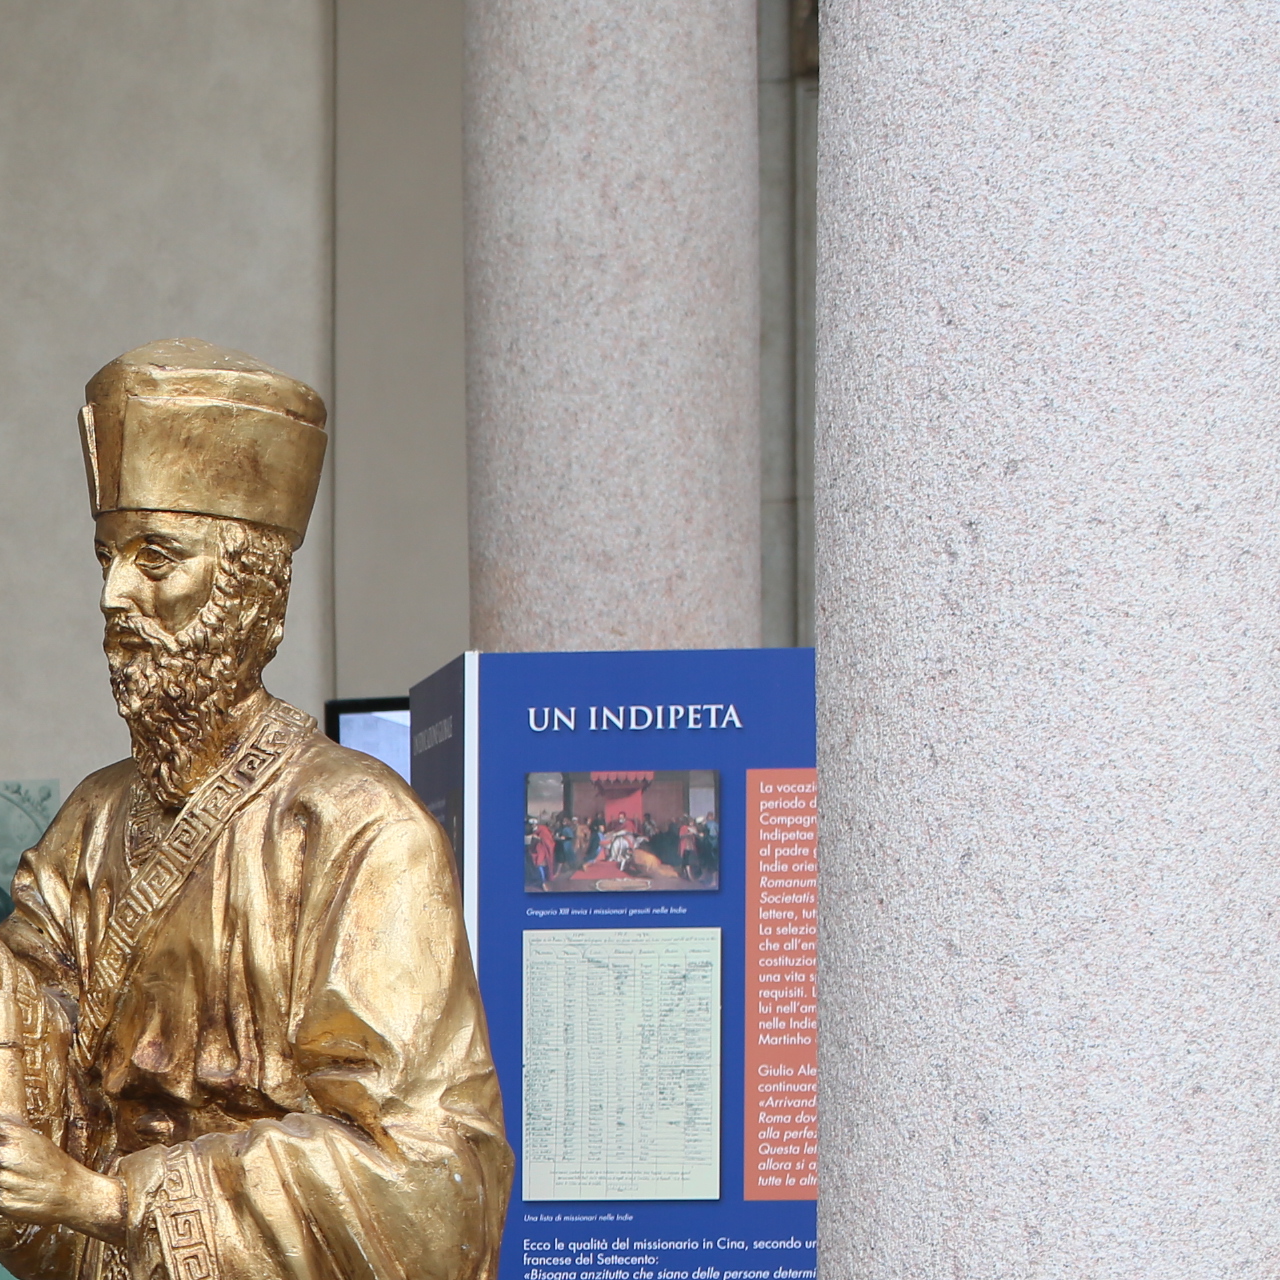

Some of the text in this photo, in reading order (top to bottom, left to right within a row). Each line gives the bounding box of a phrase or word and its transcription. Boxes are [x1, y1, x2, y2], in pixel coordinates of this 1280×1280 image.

[528, 703, 742, 731] UN INDIPETA
[760, 828, 813, 842] Indipetae
[760, 891, 814, 903] Societatis
[758, 1033, 811, 1044] Martinho
[758, 1064, 793, 1076] Giulio
[523, 1236, 802, 1253] Ecco le qualità del missionario in Cina, secondo
[523, 1251, 659, 1266] francese del Settecento:
